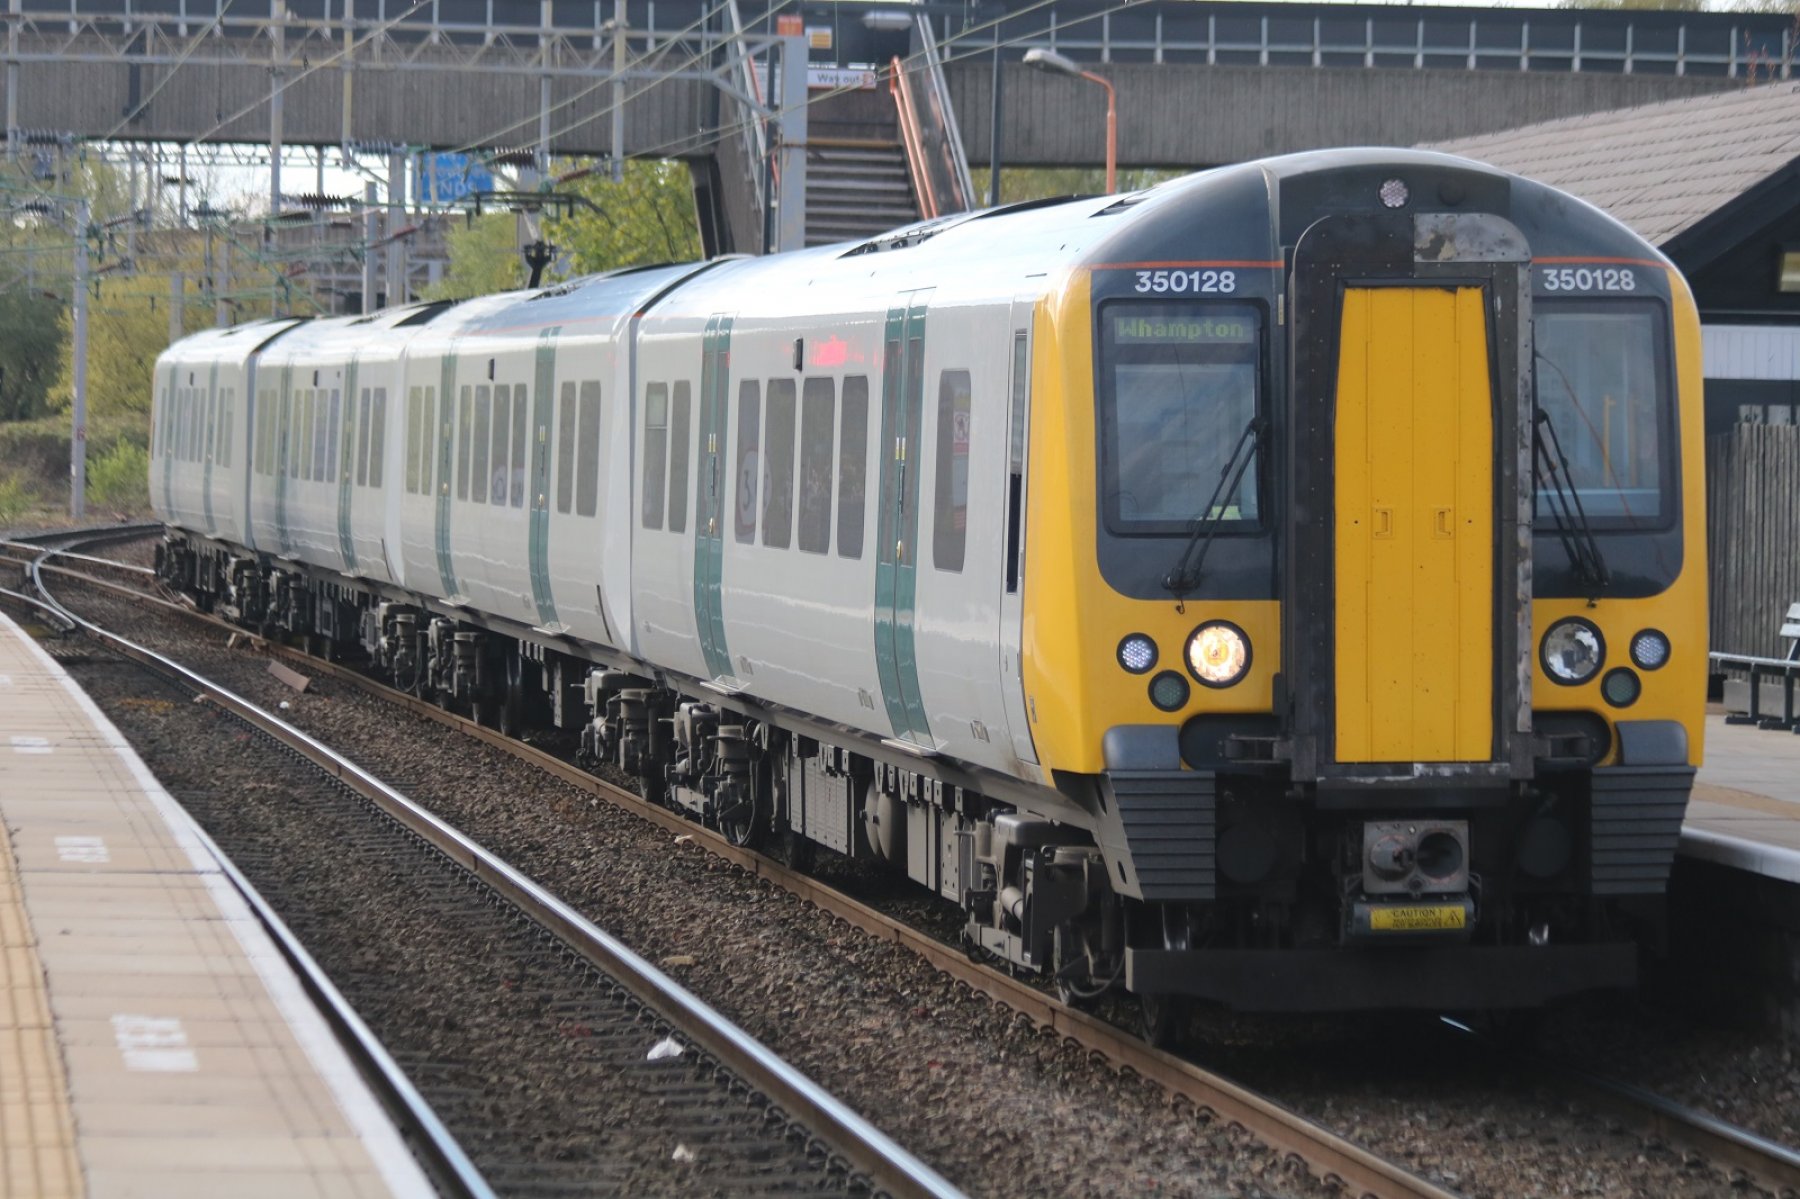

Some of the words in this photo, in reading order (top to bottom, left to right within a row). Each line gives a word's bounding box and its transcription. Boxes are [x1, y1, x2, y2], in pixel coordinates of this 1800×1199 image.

[817, 73, 839, 86] Way
[1134, 270, 1235, 293] 350128
[1543, 269, 1635, 291] 350128
[1118, 319, 1245, 340] Whampton
